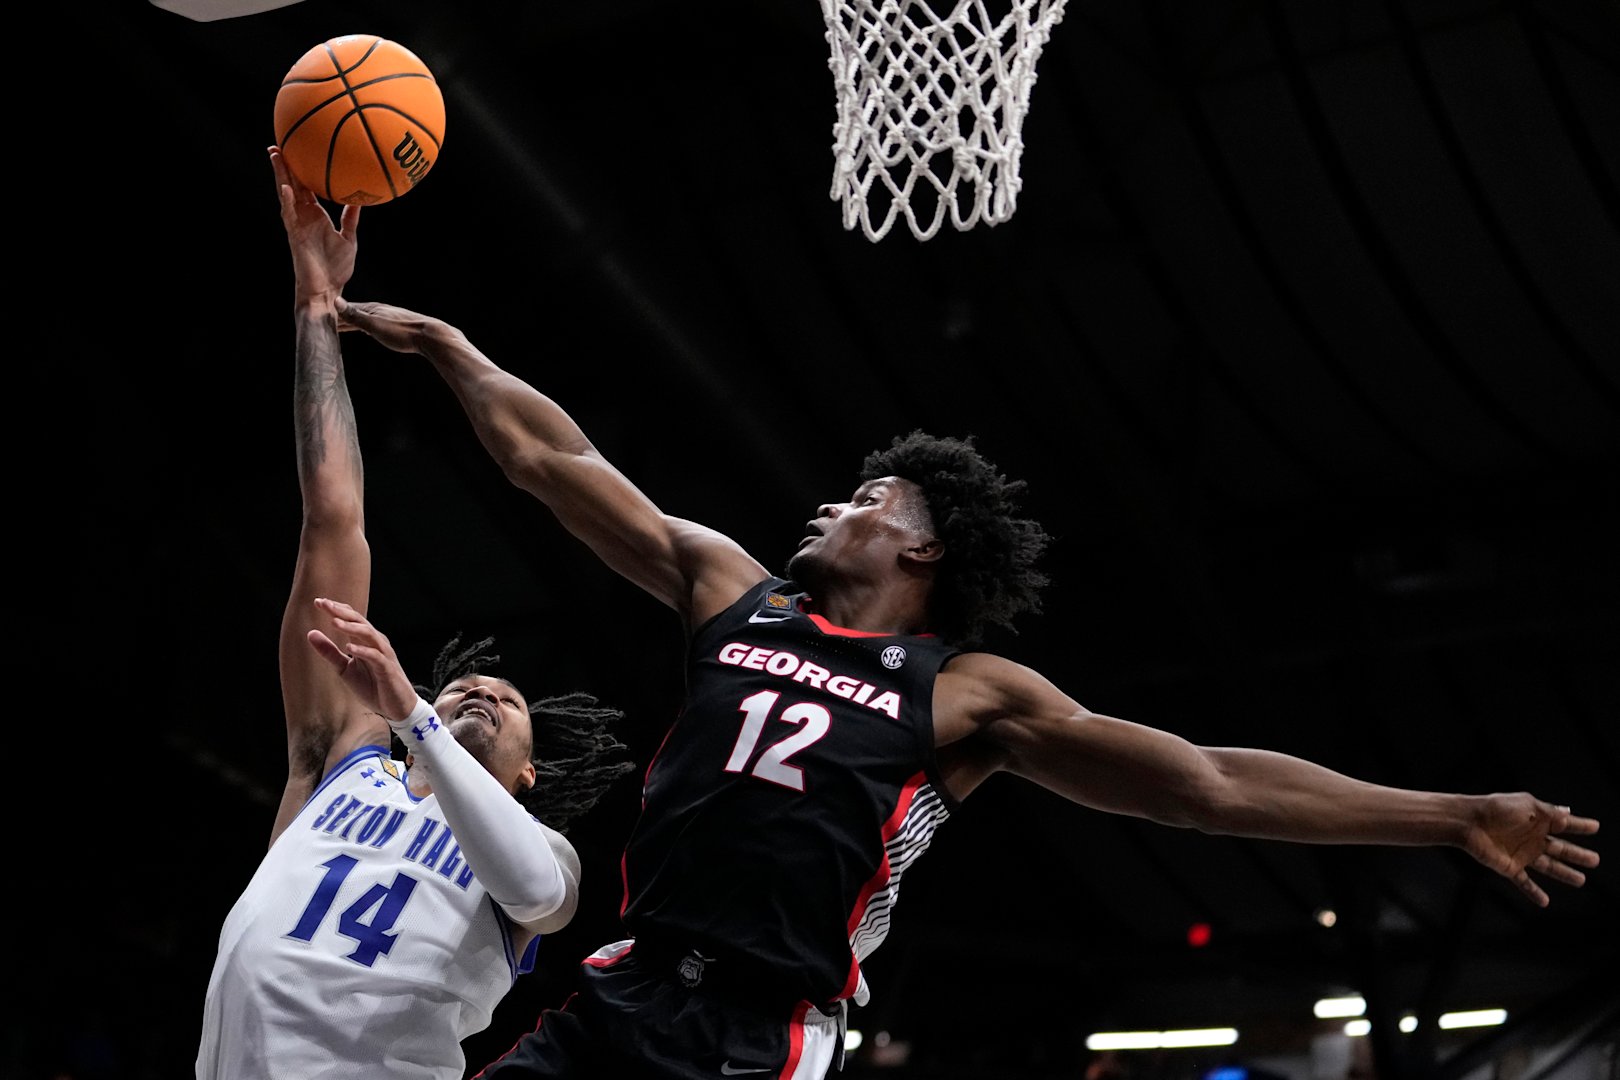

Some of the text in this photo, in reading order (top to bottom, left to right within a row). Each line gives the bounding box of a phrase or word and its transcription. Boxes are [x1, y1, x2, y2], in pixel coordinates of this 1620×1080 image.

[718, 642, 901, 720] GEORGIA
[882, 646, 906, 668] SEC
[722, 689, 832, 793] 12
[311, 793, 408, 849] SETON
[281, 853, 419, 968] 14
